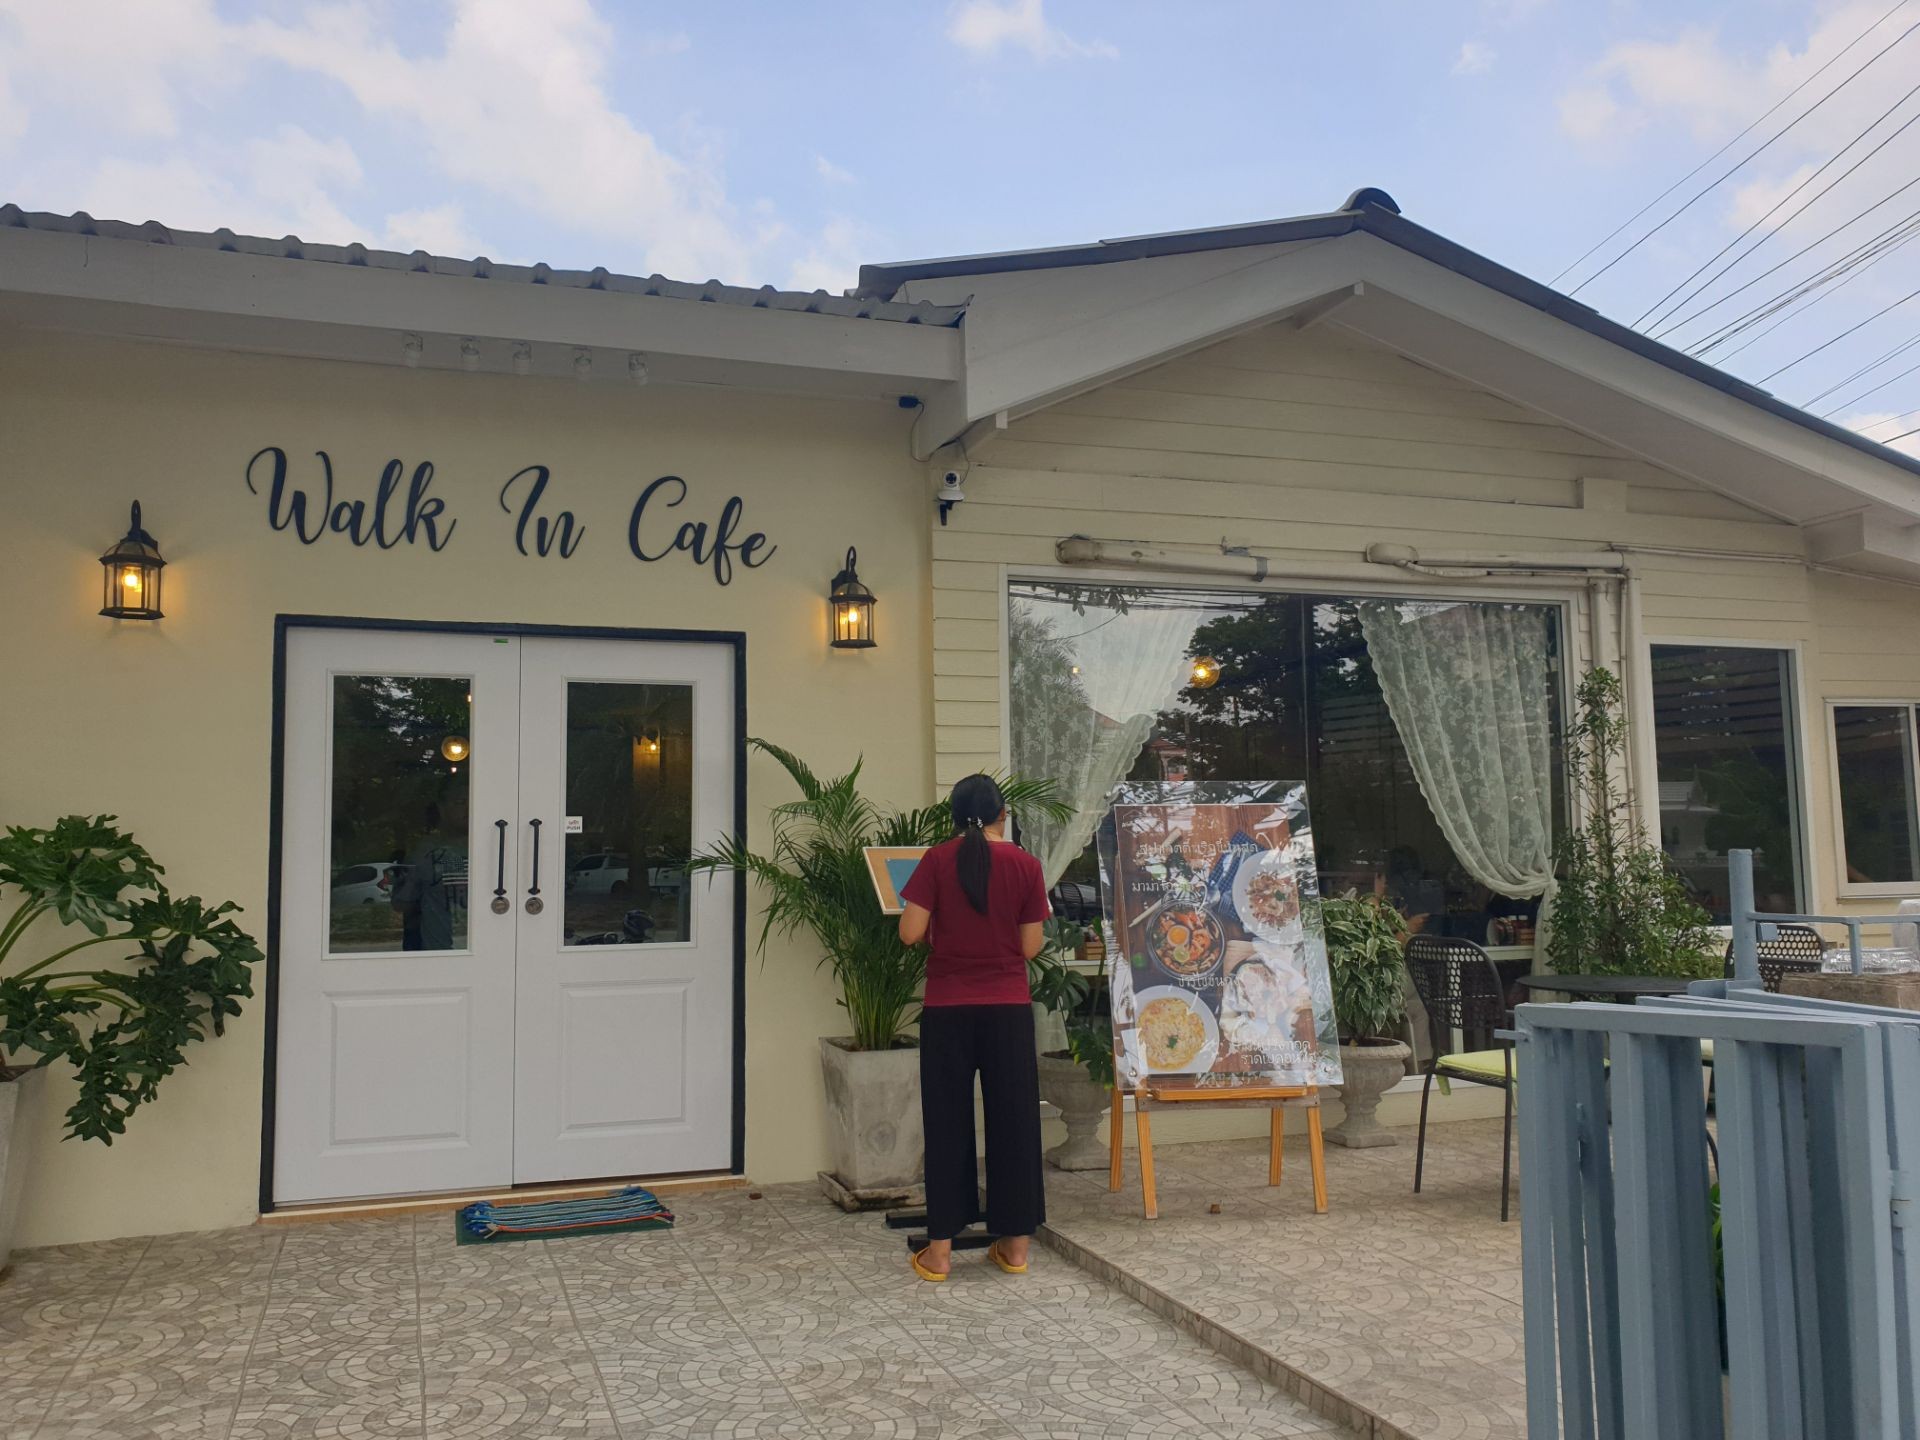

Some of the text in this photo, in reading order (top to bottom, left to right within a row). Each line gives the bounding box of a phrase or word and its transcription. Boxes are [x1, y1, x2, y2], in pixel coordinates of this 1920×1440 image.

[246, 446, 777, 586] Walk In Cafe
